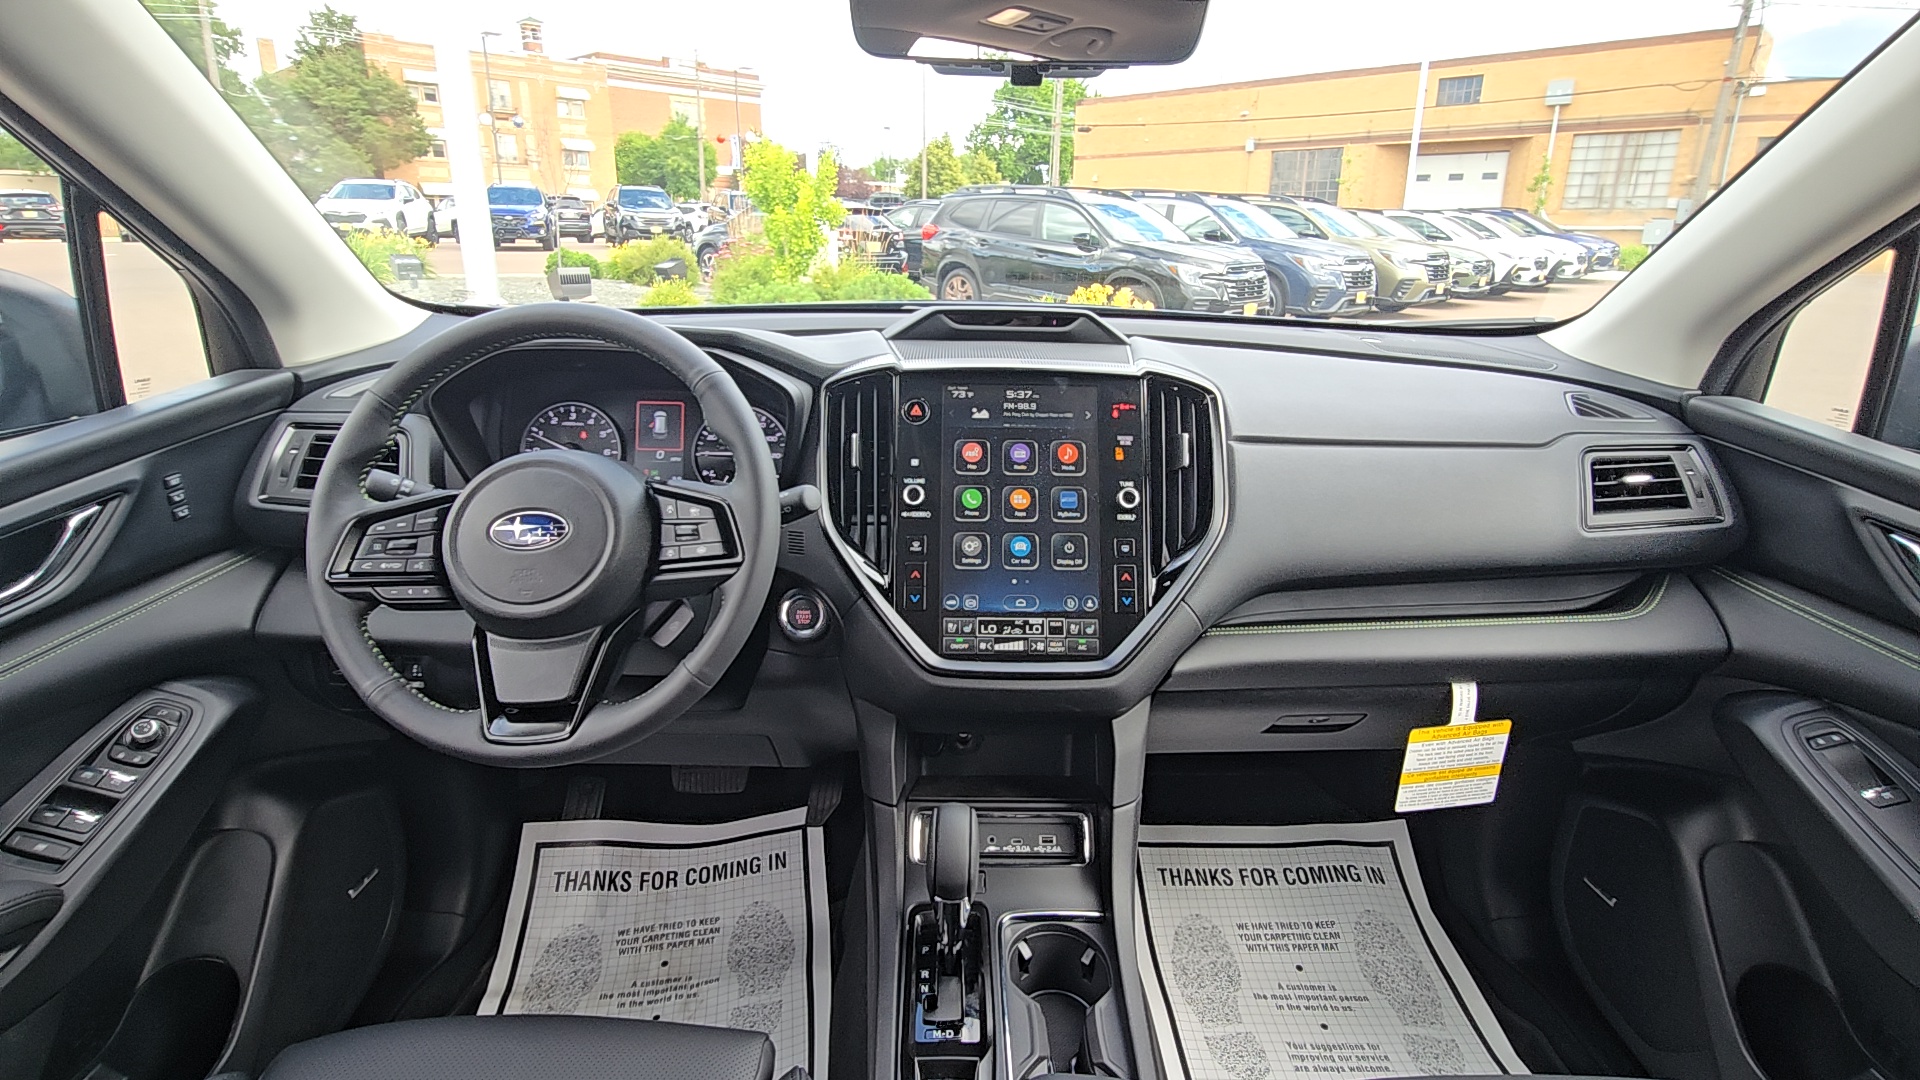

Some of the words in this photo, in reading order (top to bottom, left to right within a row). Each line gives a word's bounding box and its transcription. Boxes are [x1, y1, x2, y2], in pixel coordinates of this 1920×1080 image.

[1005, 390, 1033, 399] 5:37
[550, 417, 559, 425] 2
[569, 412, 577, 420] 3
[599, 430, 607, 438] 5
[603, 448, 611, 456] 6
[656, 450, 665, 459] 0
[980, 624, 997, 634] LO
[1025, 624, 1042, 634] LO
[553, 870, 632, 893] THANKS
[639, 871, 679, 892] FOR
[685, 856, 762, 886] COMING
[768, 851, 787, 871] IN
[1157, 867, 1234, 887] THANKS
[1238, 867, 1278, 886] FOR
[1283, 864, 1362, 886] COMING
[1364, 865, 1386, 885] IN
[617, 928, 631, 937] WE
[633, 924, 655, 935] HAVE
[658, 921, 684, 931] TRIED
[686, 919, 697, 928] TO
[699, 917, 720, 926] KEEP
[1236, 922, 1250, 931] WE
[1251, 922, 1273, 931] HAVE
[1274, 922, 1300, 931] TRIED
[1301, 921, 1313, 930] TO
[1315, 920, 1336, 929] KEEP
[615, 937, 640, 947] YOUR
[642, 930, 690, 944] CARPETING
[693, 927, 720, 937] CLEAN
[1238, 933, 1262, 942] YOUR
[1264, 932, 1311, 941] CARPETING
[1313, 931, 1341, 940] CLEAN
[618, 945, 641, 956] WITH
[644, 942, 664, 953] THIS
[666, 940, 694, 950] PAPER
[697, 937, 715, 946] MAT
[922, 946, 929, 955] P
[1246, 944, 1269, 952] WITH
[1270, 944, 1290, 952] THIS
[1291, 943, 1319, 952] PAPER
[1321, 942, 1339, 951] MAT
[921, 970, 930, 979] R
[631, 980, 637, 988] A
[640, 976, 682, 988] customer
[1277, 982, 1284, 990] A
[1286, 983, 1326, 992] customer
[1328, 983, 1337, 991] is
[617, 990, 640, 999] most
[643, 983, 687, 997] important
[690, 976, 720, 991] person
[921, 985, 929, 993] N
[616, 1001, 626, 1009] in
[629, 999, 644, 1008] the
[647, 994, 672, 1005] world
[1270, 993, 1292, 1001] most
[1294, 993, 1336, 1003] important
[1338, 994, 1369, 1003] person
[1275, 1003, 1285, 1011] in
[1286, 1003, 1301, 1011] the
[1303, 1003, 1329, 1012] world
[1285, 1041, 1307, 1050] Your
[1310, 1043, 1365, 1053] suggestions
[1366, 1043, 1380, 1051] for
[1337, 1054, 1353, 1062] our
[1355, 1053, 1391, 1061] service
[1294, 1064, 1310, 1072] are
[1312, 1064, 1346, 1074] always
